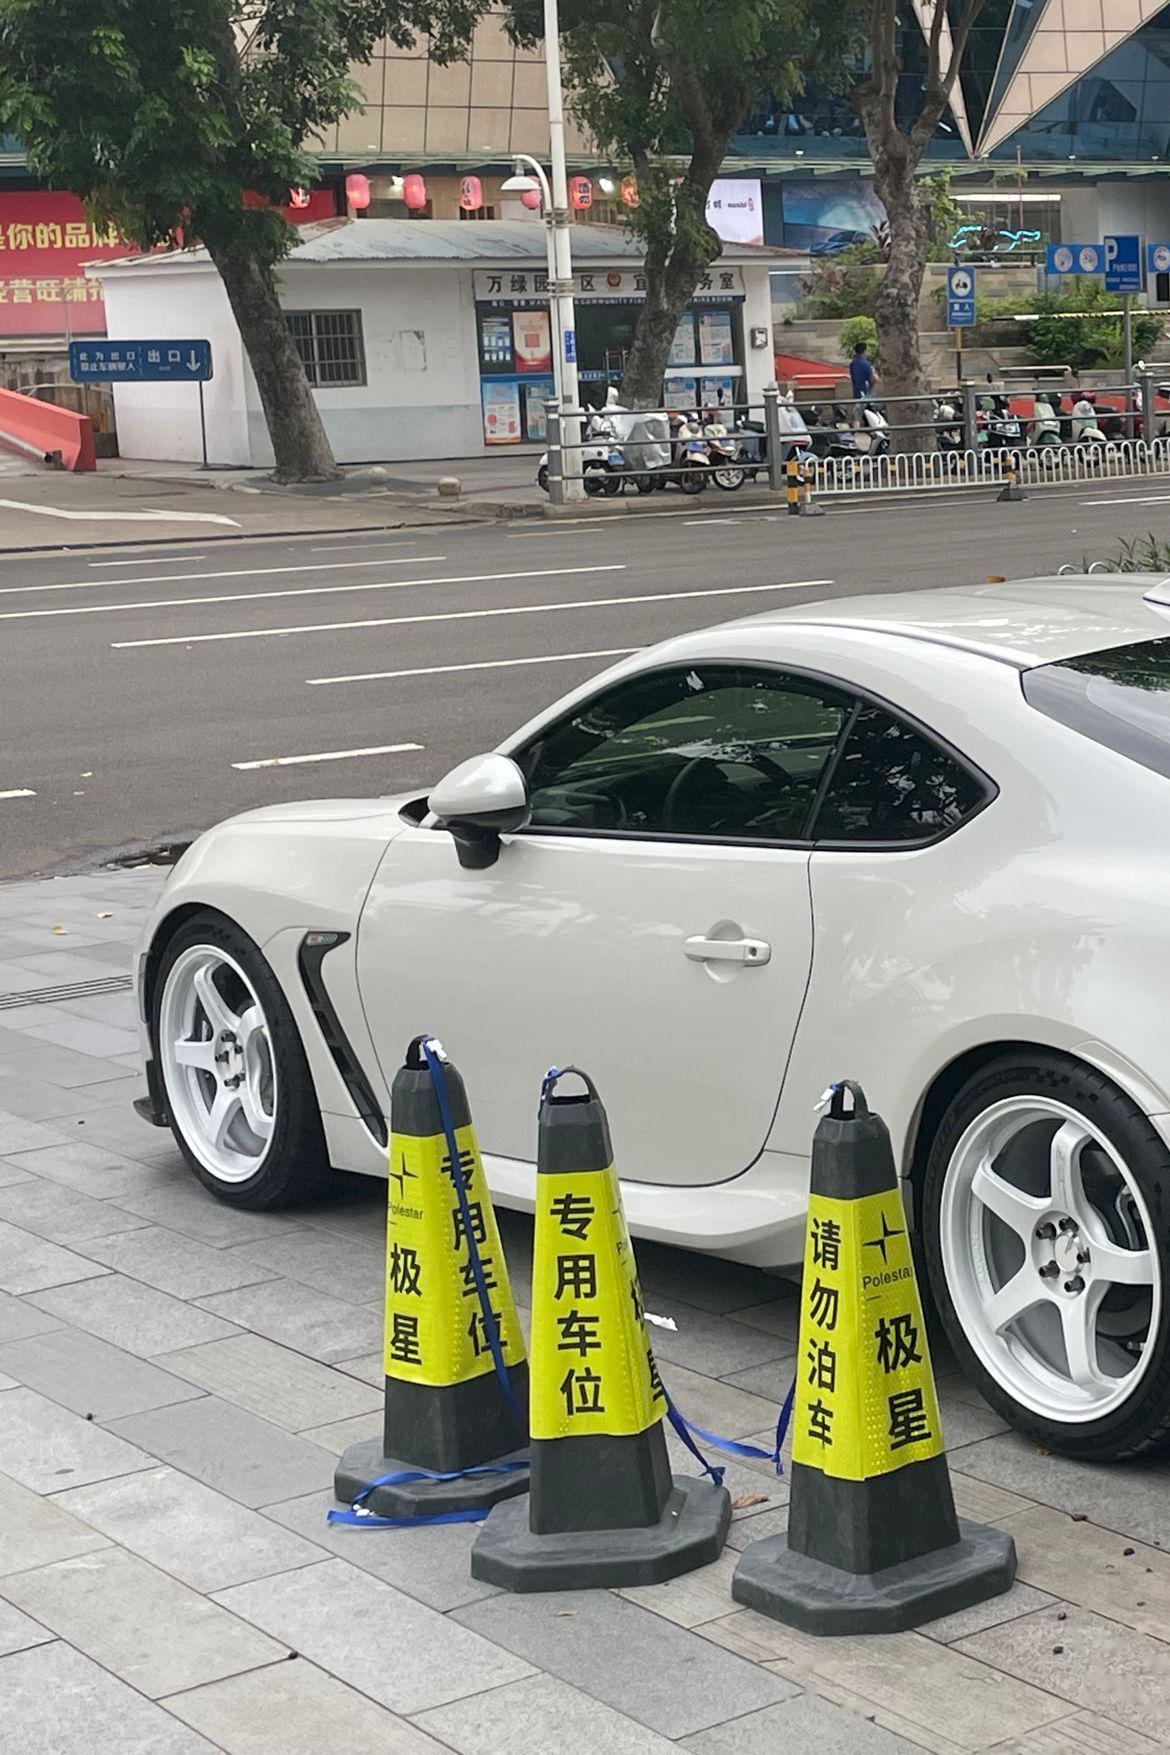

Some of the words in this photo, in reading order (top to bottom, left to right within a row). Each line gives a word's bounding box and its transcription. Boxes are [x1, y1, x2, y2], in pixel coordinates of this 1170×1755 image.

[0, 222, 119, 250] 你的品牌
[486, 274, 596, 293] 万绿园区
[147, 349, 181, 363] 出口
[390, 1242, 423, 1366] 极星
[550, 1193, 605, 1417] 专用车位
[807, 1216, 842, 1450] 请勿泊车
[874, 1312, 932, 1451] 极星
